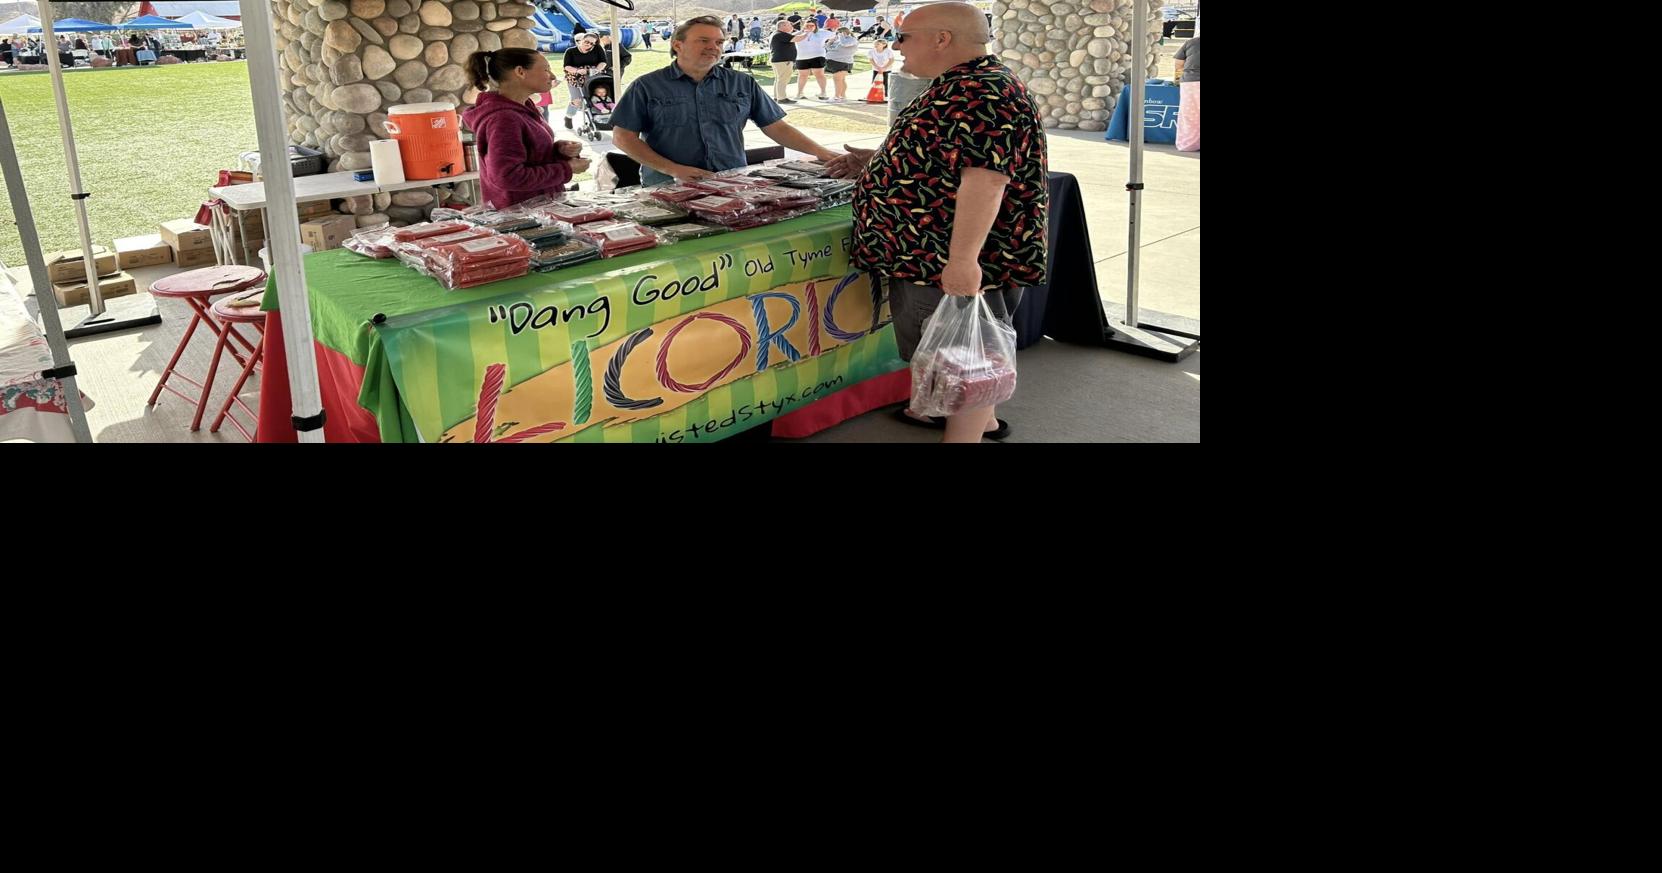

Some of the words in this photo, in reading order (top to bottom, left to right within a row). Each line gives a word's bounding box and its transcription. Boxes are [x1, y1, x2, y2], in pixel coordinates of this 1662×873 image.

[744, 259, 775, 277] Old
[783, 244, 833, 270] Tyme
[656, 375, 843, 443] istedStyx.com
